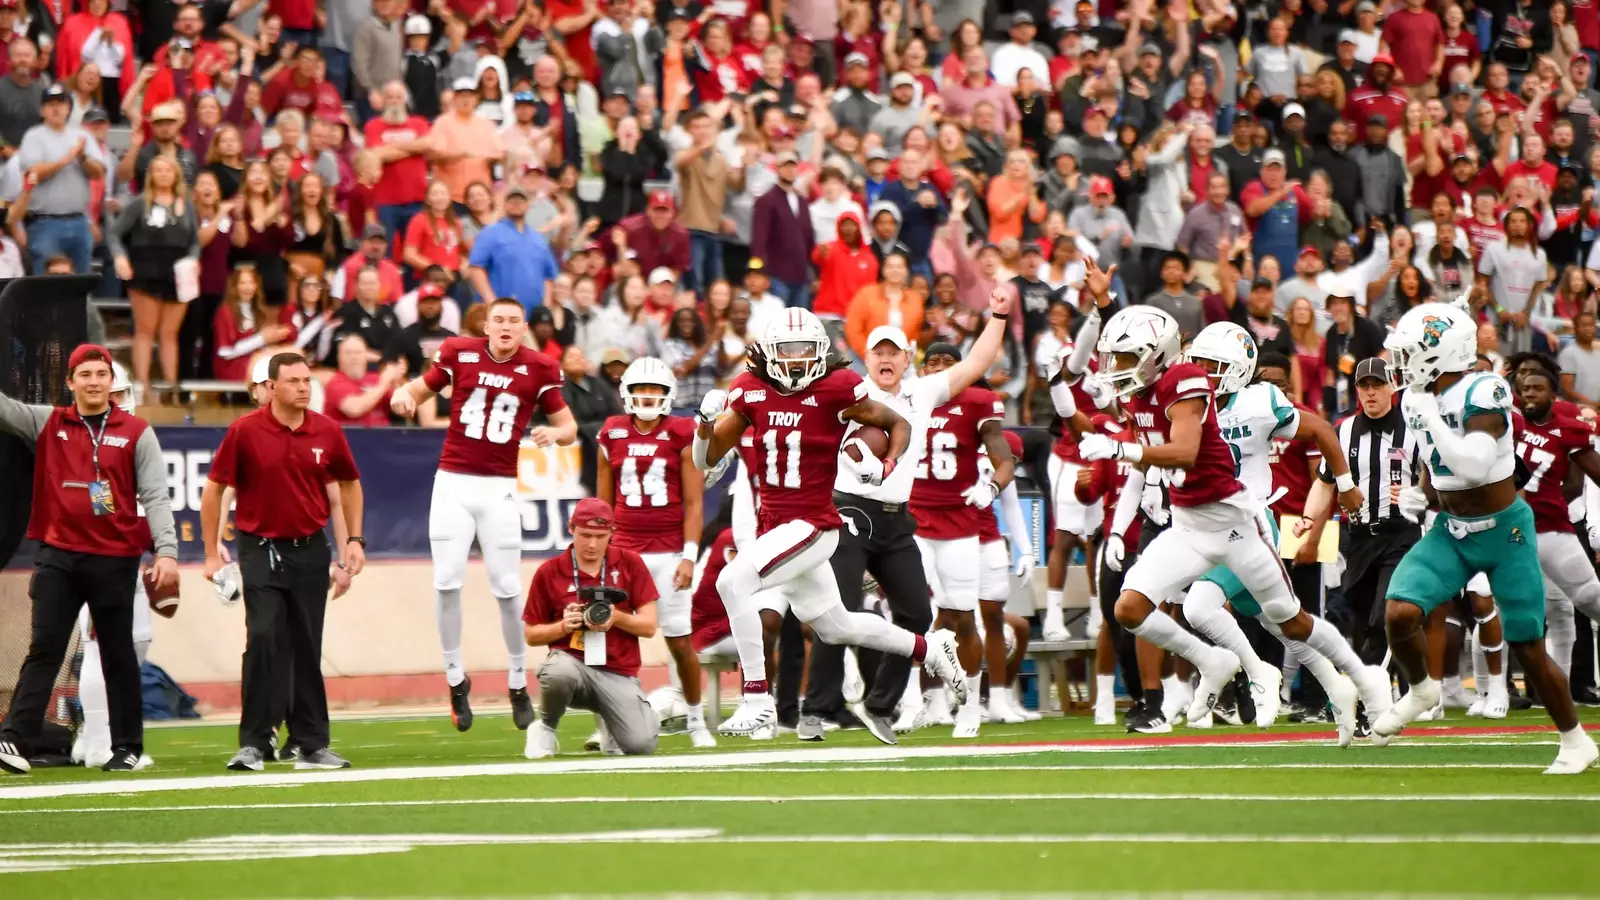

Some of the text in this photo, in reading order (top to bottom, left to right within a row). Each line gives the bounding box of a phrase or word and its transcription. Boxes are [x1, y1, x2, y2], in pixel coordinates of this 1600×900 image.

[478, 371, 513, 389] TROY
[459, 388, 520, 444] 48
[768, 411, 803, 427] TROY
[928, 416, 950, 429] ROY
[1135, 412, 1154, 428] TROY
[1223, 425, 1252, 441] TAL
[103, 435, 129, 448] TROY
[628, 443, 658, 456] TROY
[312, 447, 324, 464] T
[763, 429, 802, 488] 11
[1350, 447, 1358, 457] S
[620, 457, 668, 507] 44
